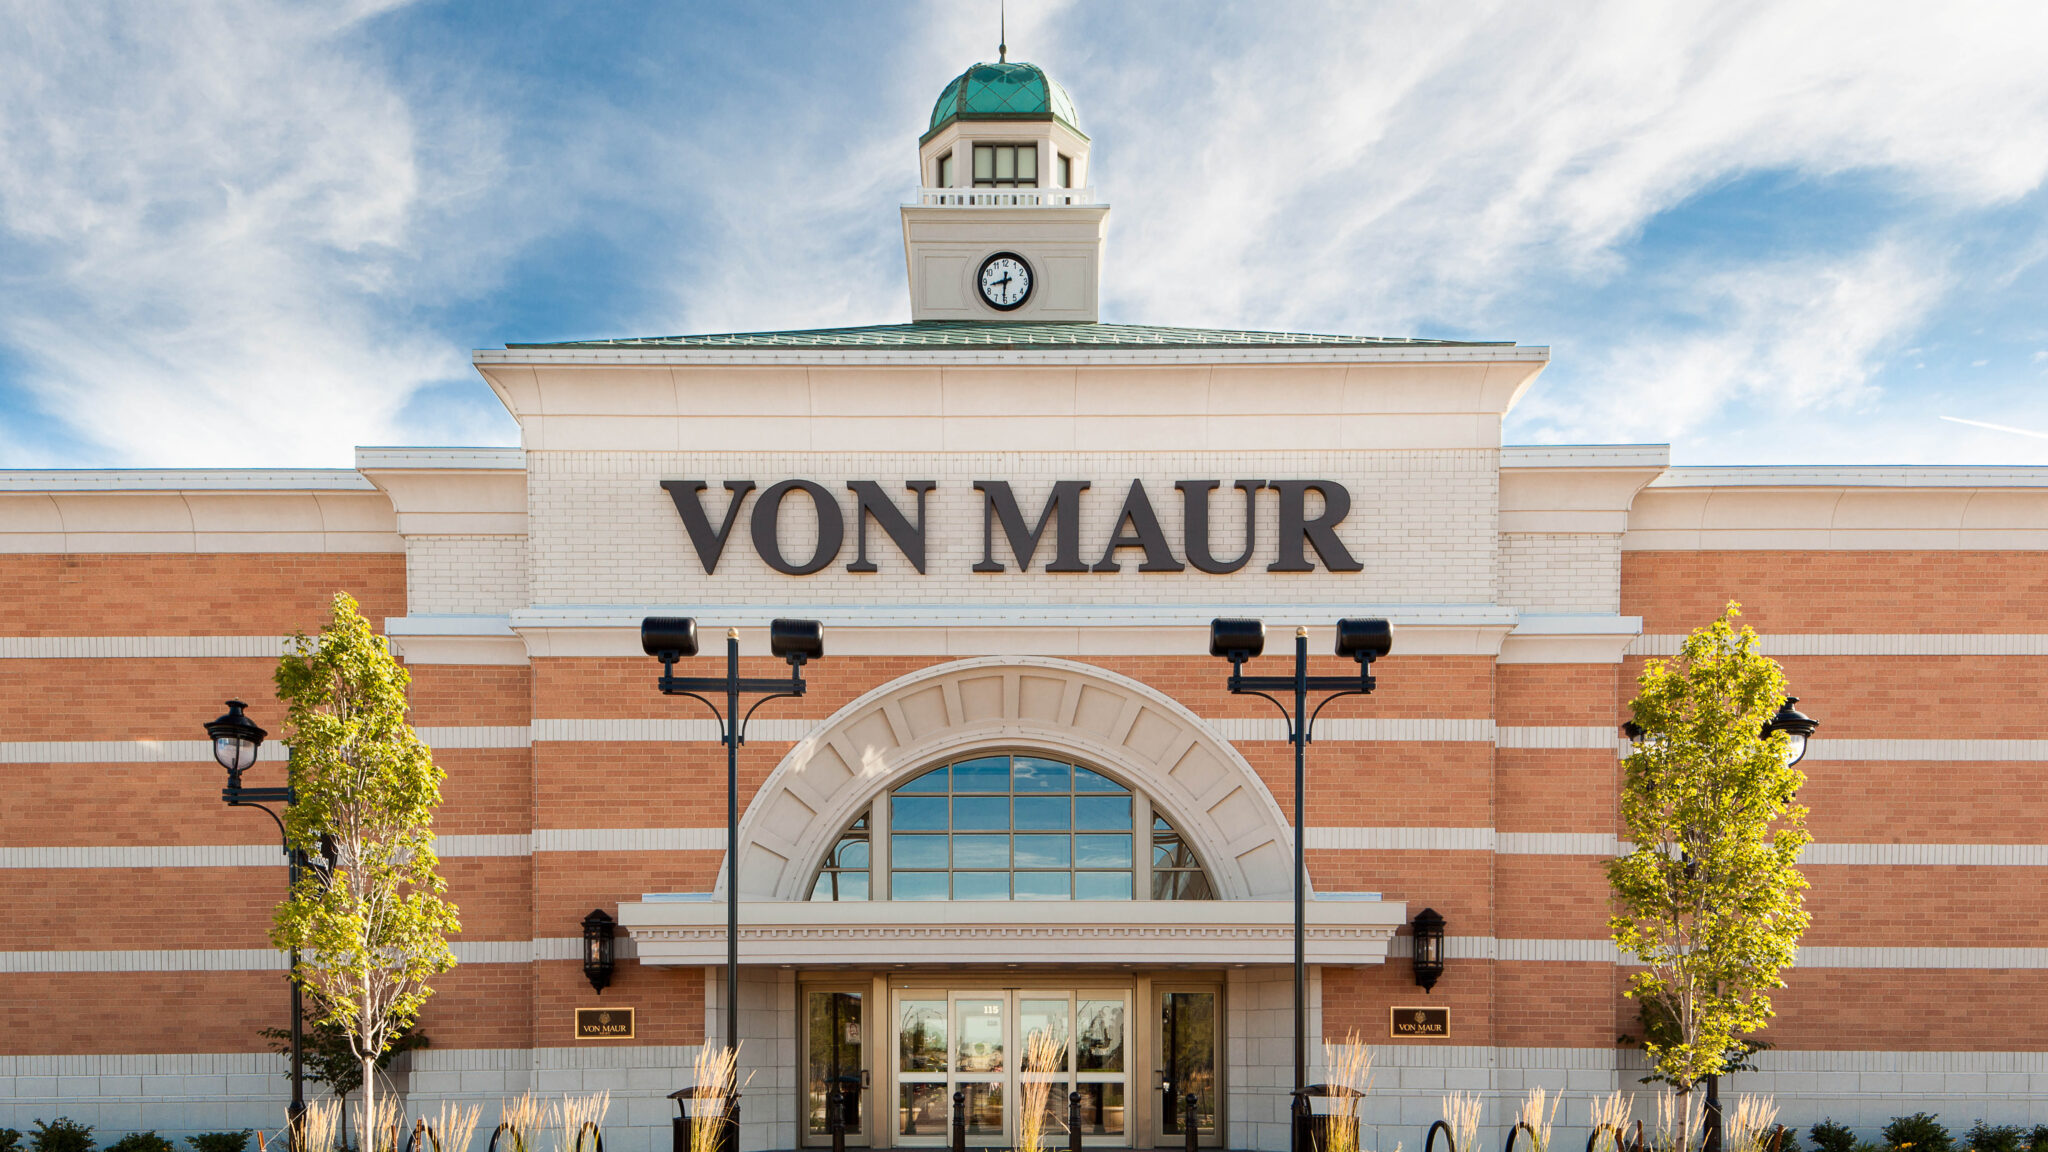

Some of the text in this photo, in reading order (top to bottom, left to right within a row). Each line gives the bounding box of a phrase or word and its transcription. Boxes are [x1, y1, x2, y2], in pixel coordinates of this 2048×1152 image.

[660, 478, 1364, 575] VON MAUR
[983, 1005, 999, 1014] 115
[602, 1024, 627, 1032] MAUR
[1398, 1023, 1442, 1031] VON MAUR
